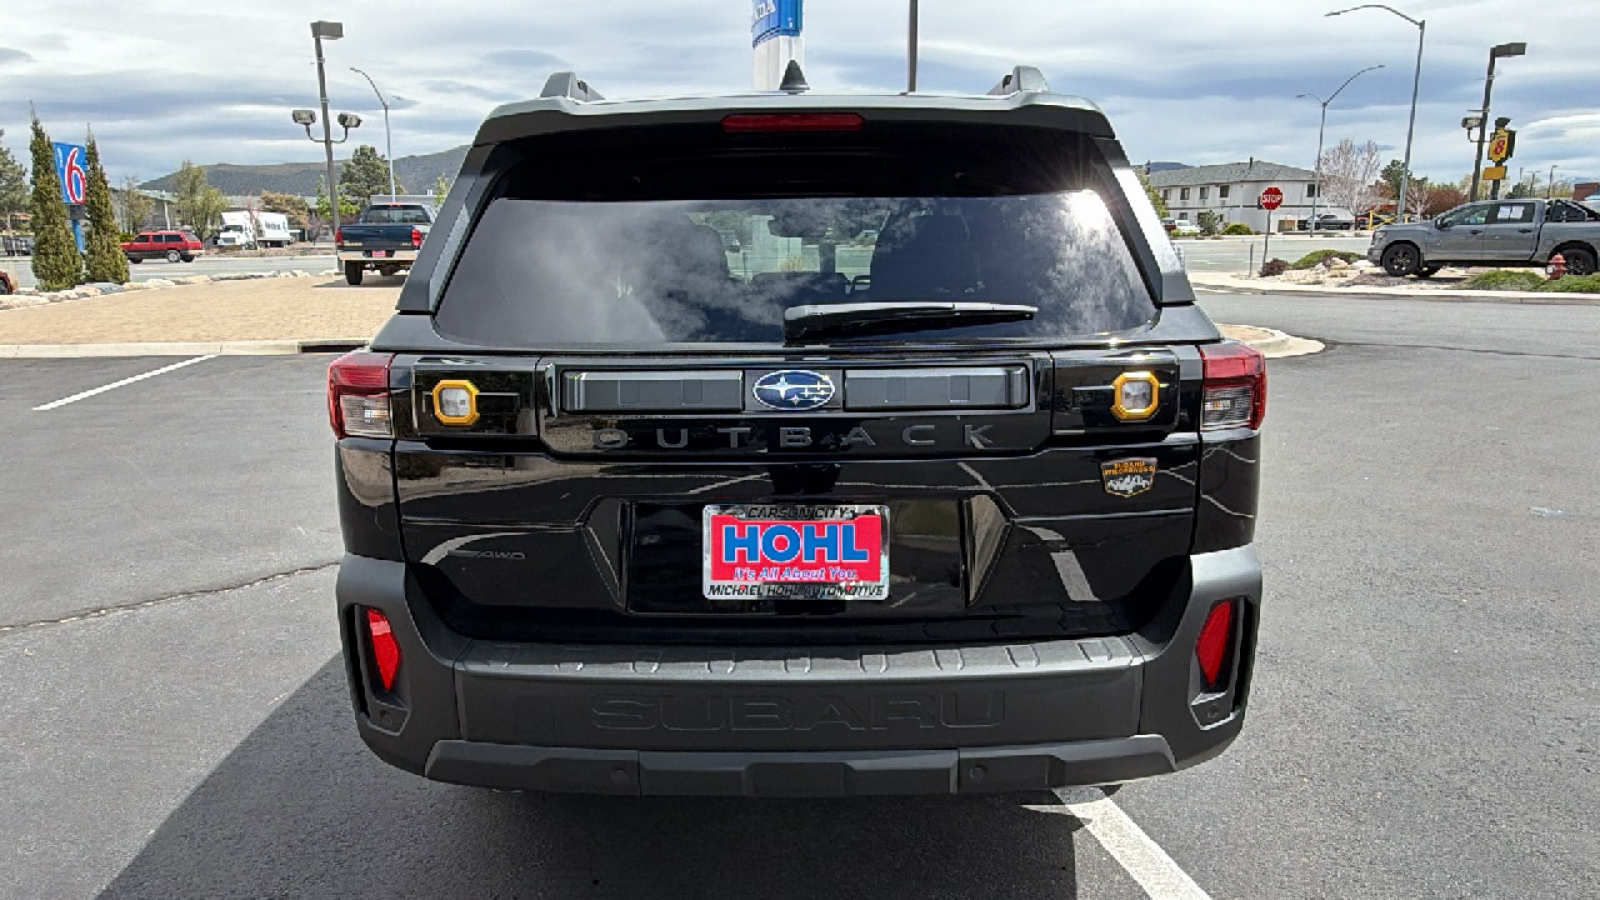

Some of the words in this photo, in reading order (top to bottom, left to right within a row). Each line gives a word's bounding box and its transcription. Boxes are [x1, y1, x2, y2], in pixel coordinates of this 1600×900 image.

[64, 147, 86, 205] 6
[1262, 194, 1282, 204] STOP
[592, 424, 994, 449] OUTBACK
[748, 507, 814, 519] CARSON
[814, 506, 848, 519] CITY
[722, 524, 869, 563] HOHL
[733, 566, 756, 580] It's
[757, 566, 780, 580] All
[780, 566, 826, 580] About
[708, 584, 763, 596] MICHAEL
[765, 584, 800, 596] HOHL
[802, 584, 884, 596] AUTOMOTIVE
[591, 691, 1005, 731] SUBARU
